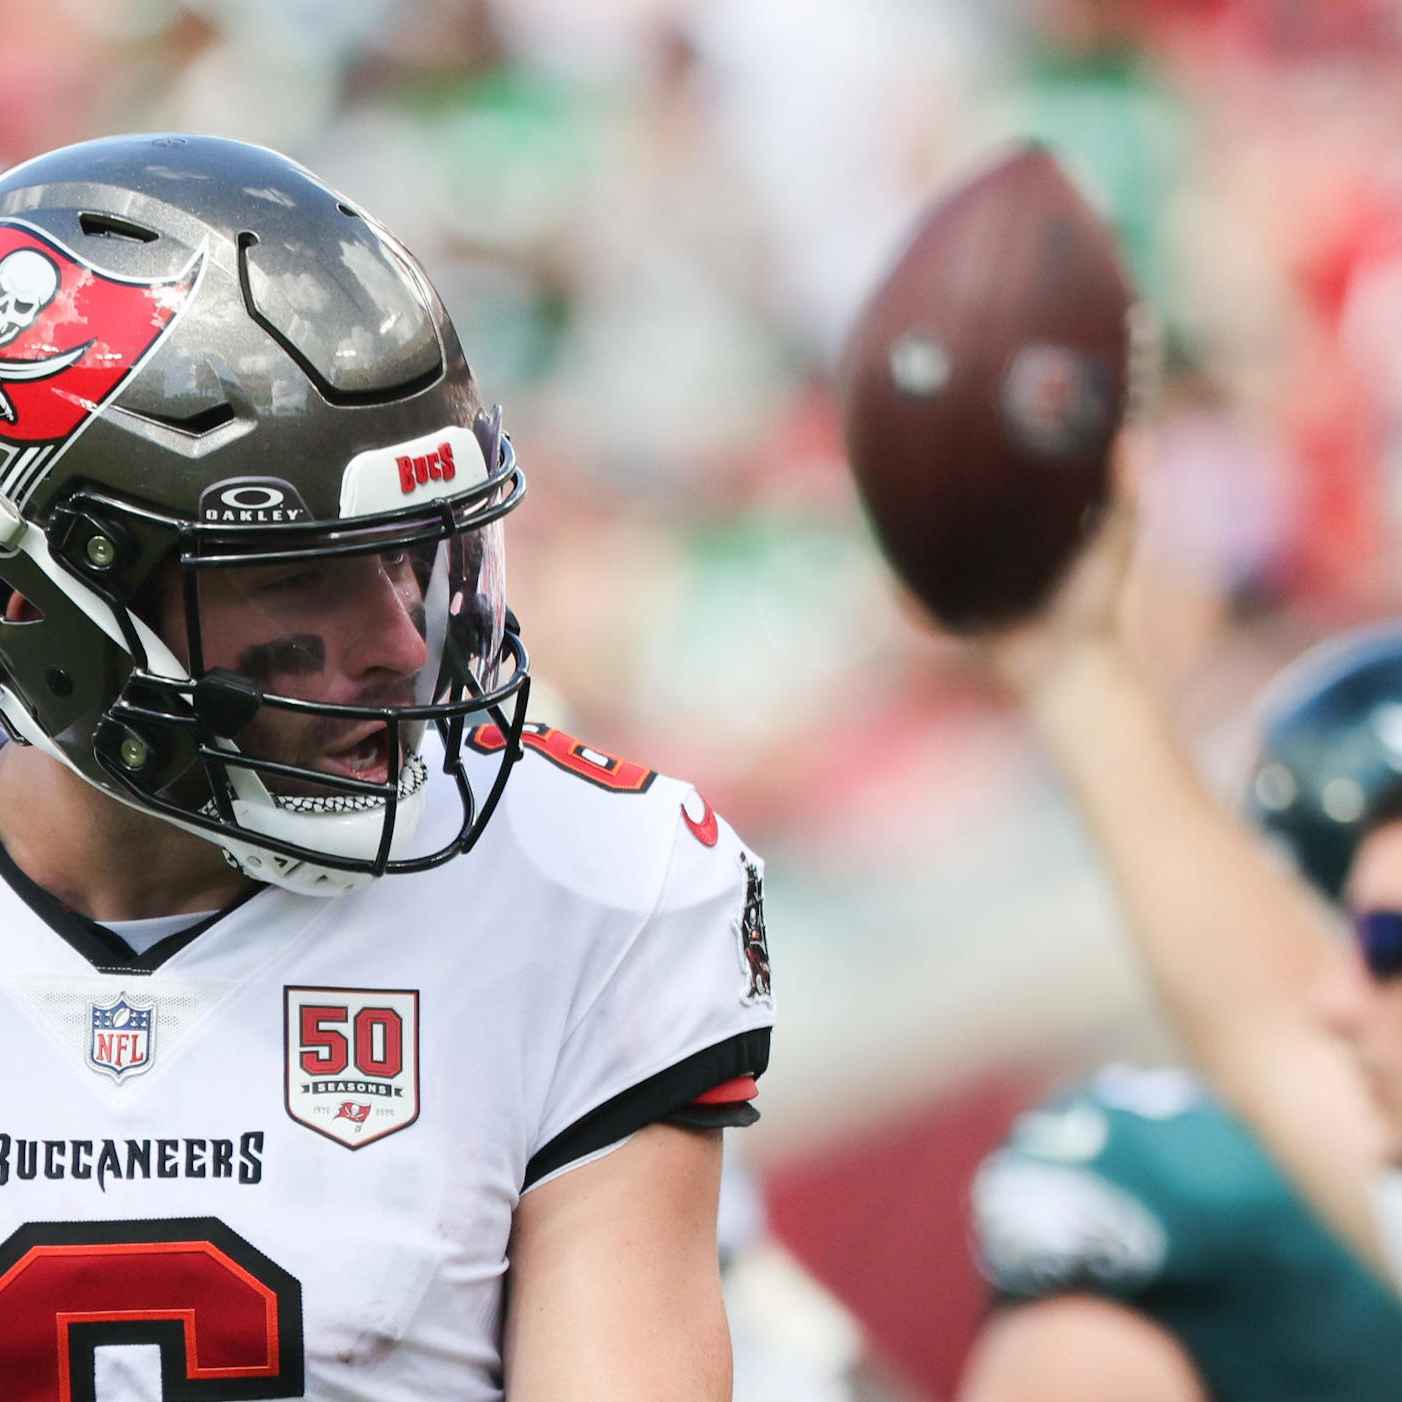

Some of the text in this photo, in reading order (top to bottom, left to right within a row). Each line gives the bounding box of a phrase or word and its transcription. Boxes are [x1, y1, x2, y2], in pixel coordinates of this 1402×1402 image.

[205, 509, 300, 521] OAKLEY
[96, 1033, 144, 1067] NFL
[299, 1004, 403, 1079] 50
[317, 1082, 387, 1094] SEASONS
